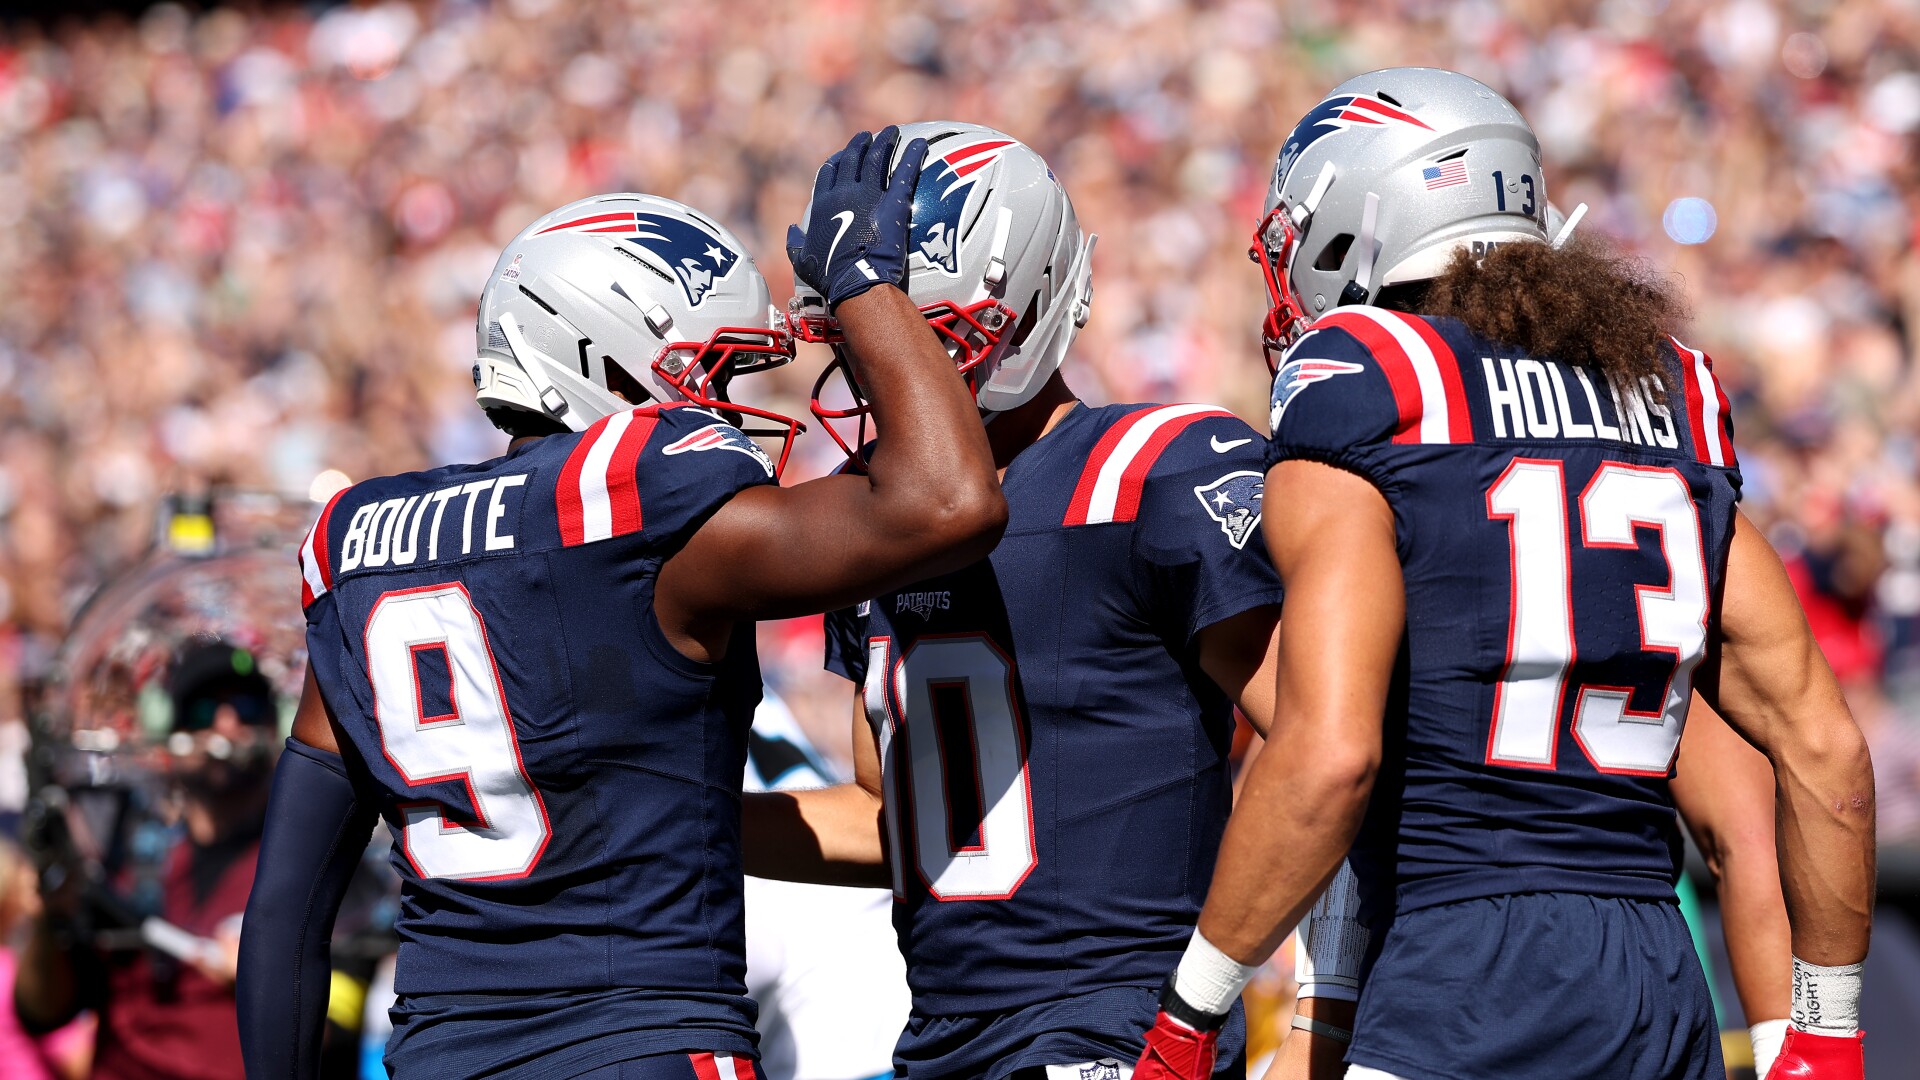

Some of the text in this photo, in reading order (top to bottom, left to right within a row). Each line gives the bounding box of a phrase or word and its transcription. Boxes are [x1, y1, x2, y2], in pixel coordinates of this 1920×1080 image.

[1491, 170, 1536, 216] 13
[1481, 357, 1680, 450] HOLLINS
[339, 473, 529, 574] BOUTTE
[896, 591, 951, 614] PATRIOTS
[1484, 456, 1711, 778] 13
[362, 580, 553, 880] 9
[1803, 971, 1822, 1024] RIGHT?
